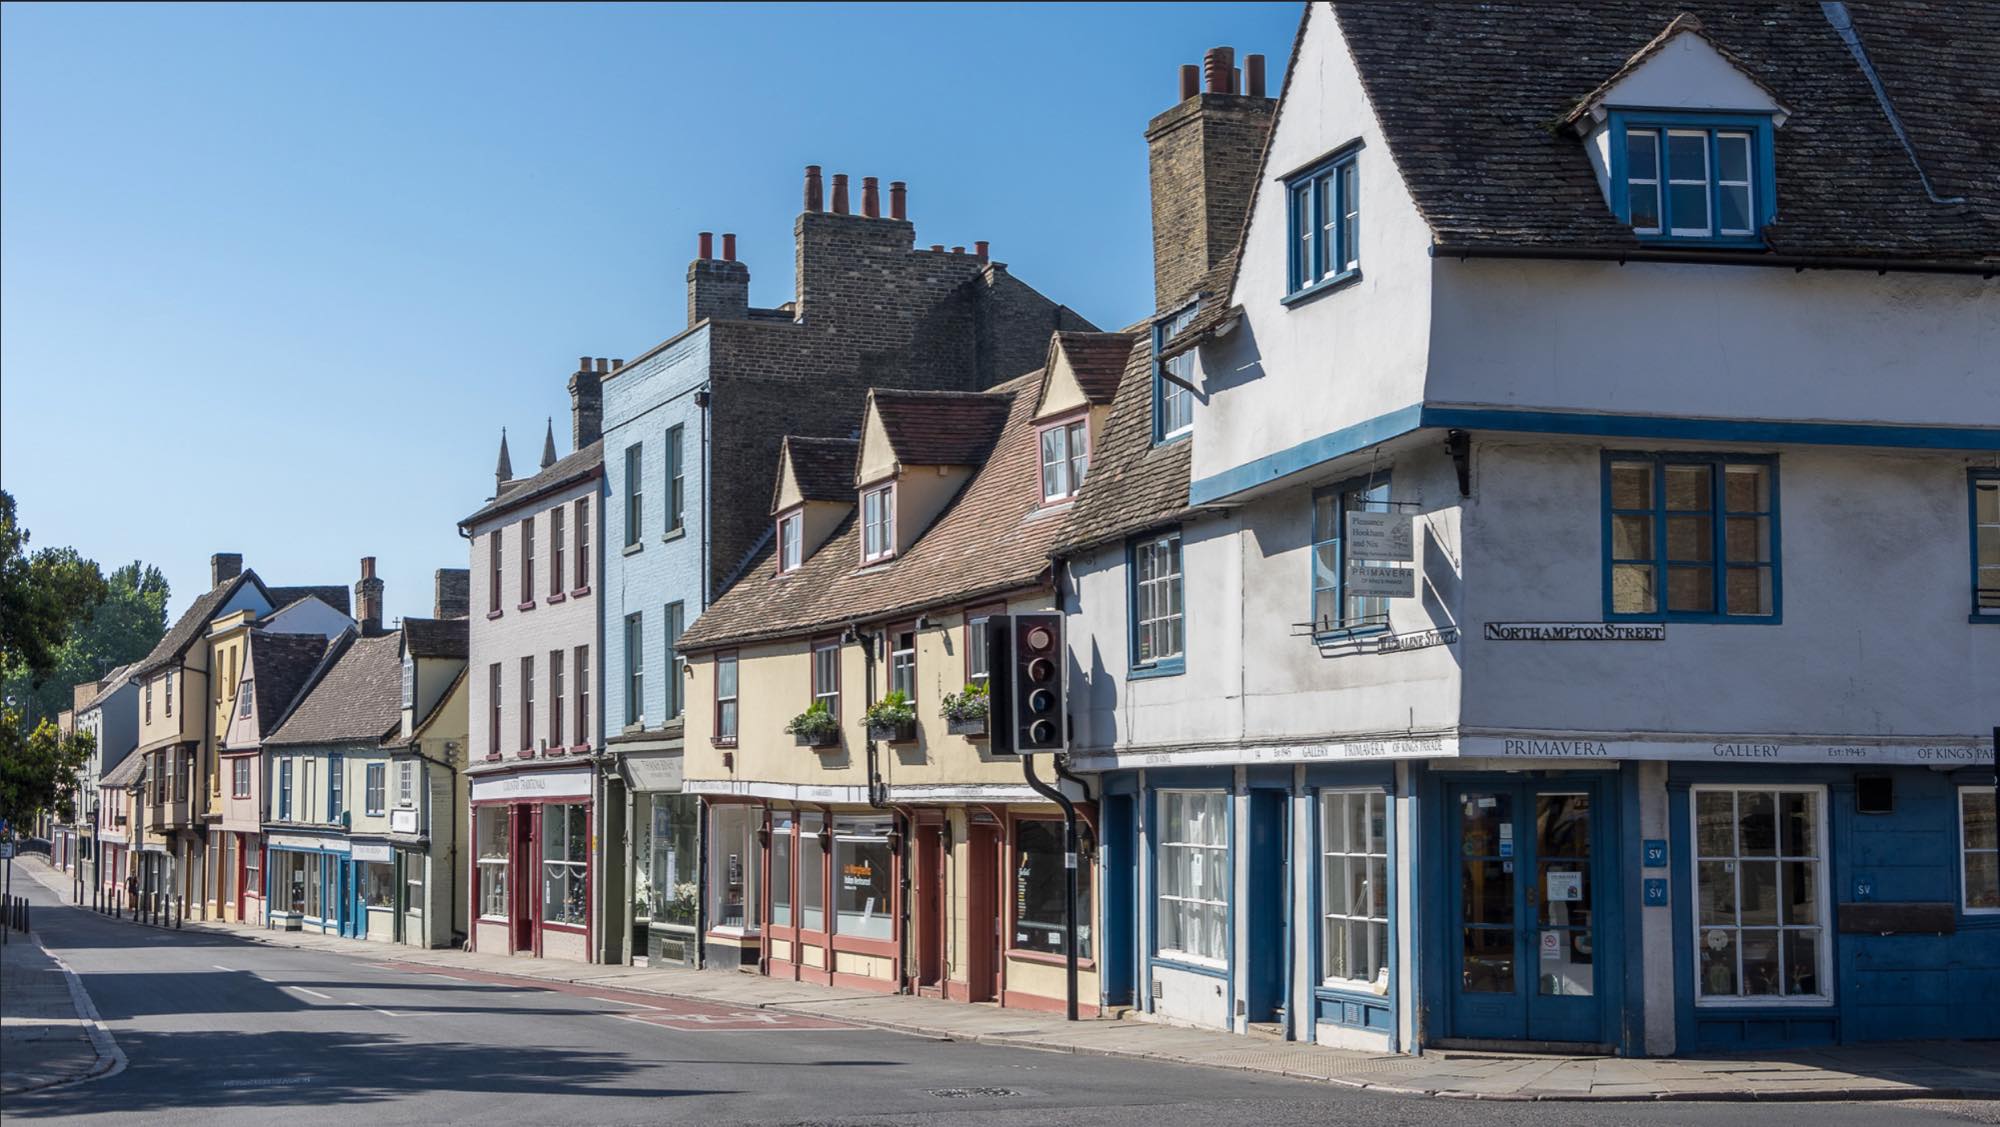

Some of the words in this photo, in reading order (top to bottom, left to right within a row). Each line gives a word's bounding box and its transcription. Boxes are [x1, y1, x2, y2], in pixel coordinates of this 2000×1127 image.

[1352, 567, 1412, 577] PRIMAVERA
[1302, 745, 1328, 758] GALLERY
[1344, 742, 1385, 757] PRIMAVERA
[1505, 740, 1607, 756] PRIMAVERA
[1713, 744, 1780, 757] GALLERY
[1845, 746, 1866, 757] 1945
[1918, 748, 1932, 759] OF
[1649, 849, 1661, 859] SV
[1650, 888, 1662, 898] SV
[1858, 884, 1870, 895] SV
